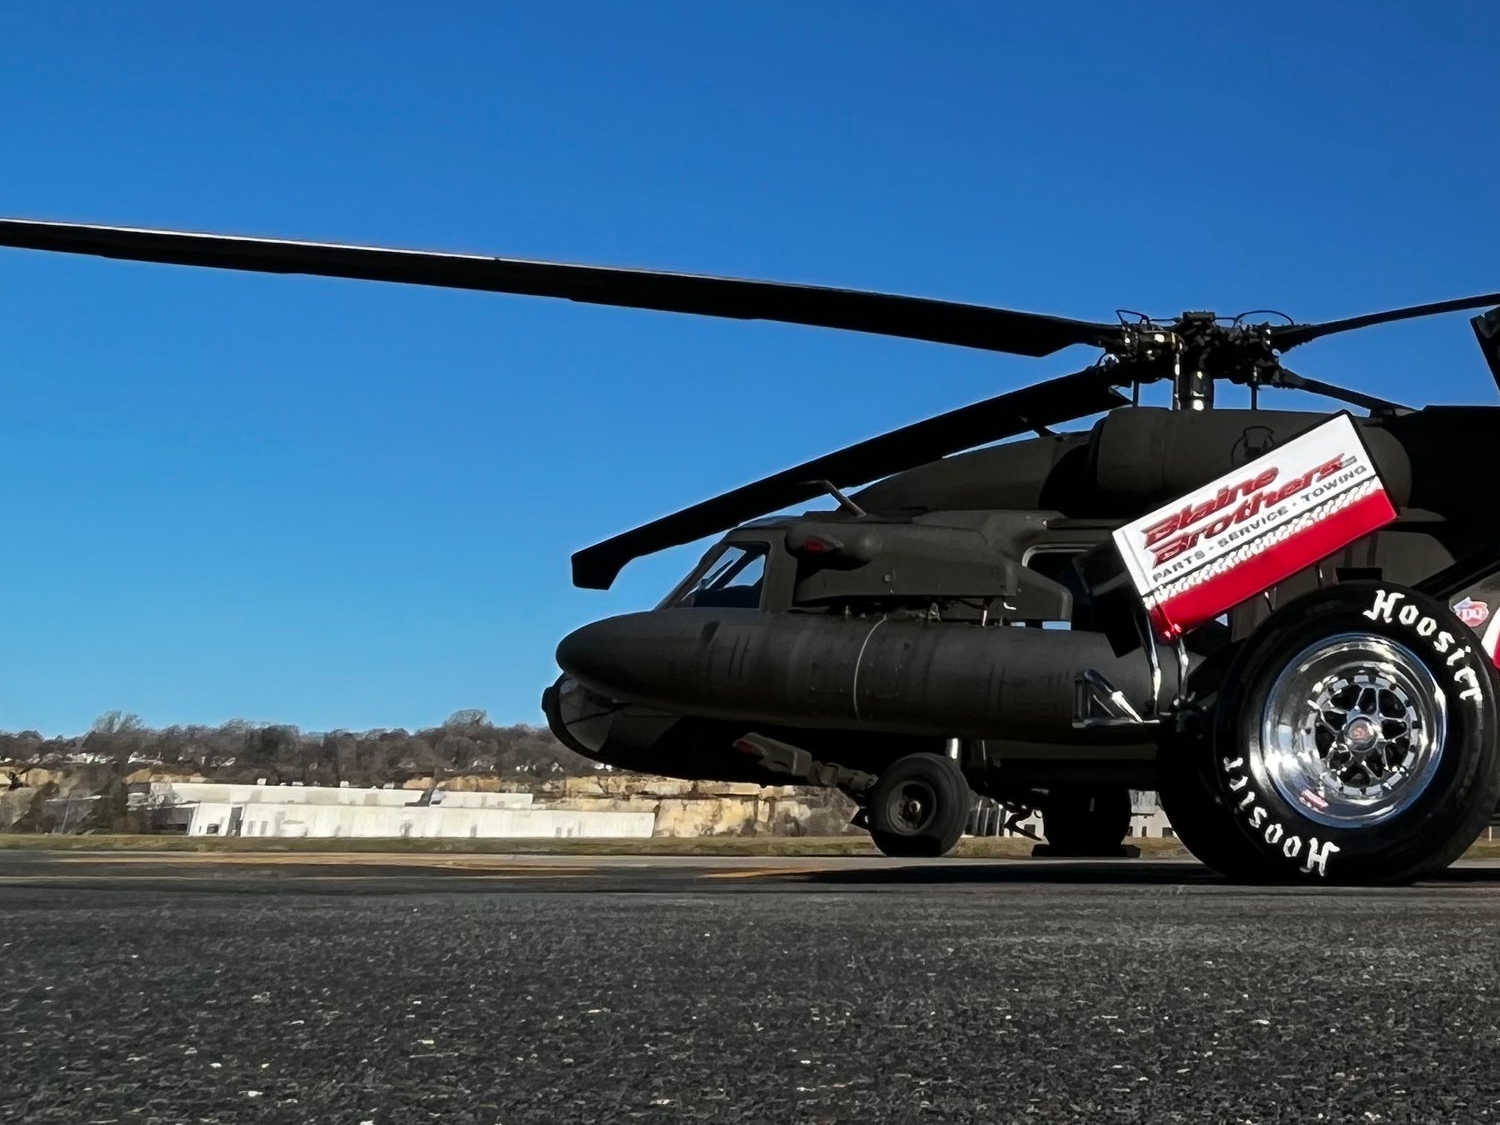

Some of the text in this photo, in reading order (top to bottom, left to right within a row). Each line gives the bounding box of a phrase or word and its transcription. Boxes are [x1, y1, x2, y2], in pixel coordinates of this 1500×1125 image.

[1143, 466, 1280, 549] Blaine
[1150, 454, 1345, 569] Brothers
[1152, 465, 1369, 583] PARTS SERVICE TOWING
